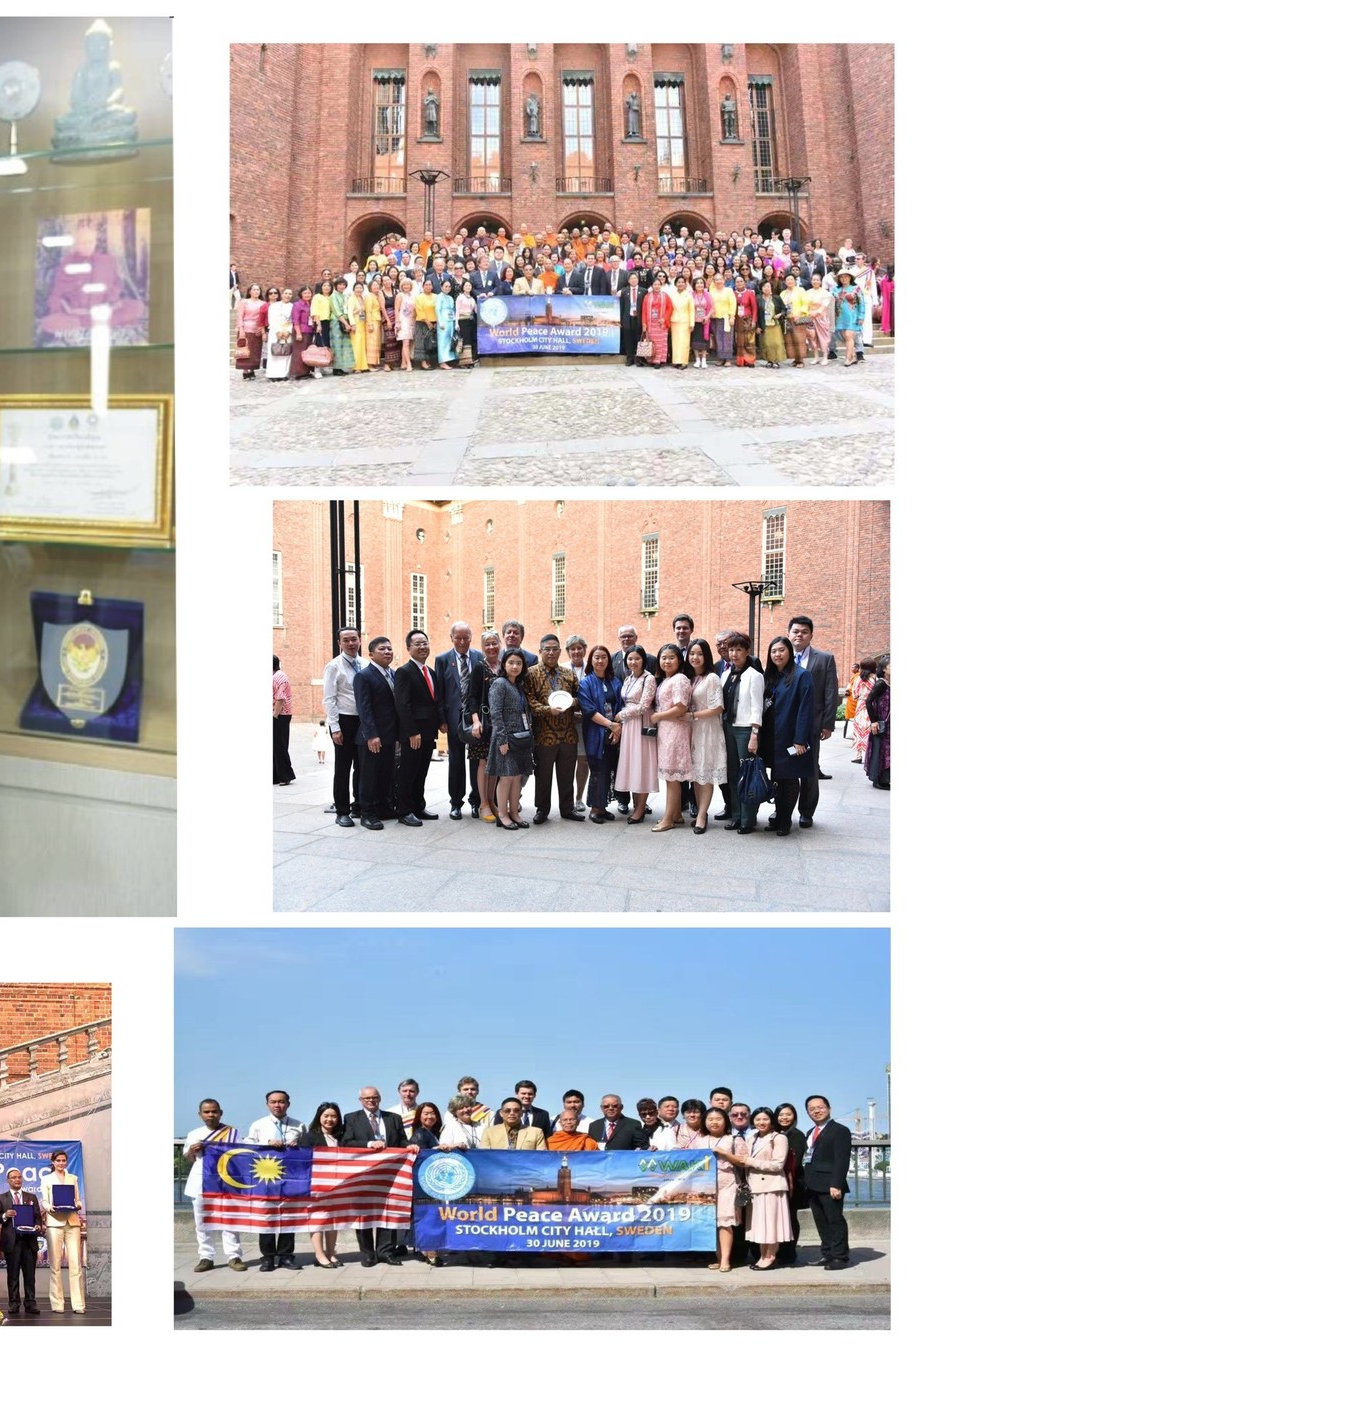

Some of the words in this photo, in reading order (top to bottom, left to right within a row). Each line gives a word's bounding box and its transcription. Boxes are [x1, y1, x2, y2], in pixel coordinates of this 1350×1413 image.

[490, 328, 519, 337] World
[521, 327, 548, 336] Peace
[550, 328, 581, 336] Award
[584, 328, 609, 336] 2019
[0, 1152, 14, 1160] CITY
[438, 1206, 498, 1221] World
[503, 1207, 562, 1222] Peace
[568, 1207, 635, 1222] Award
[640, 1207, 691, 1222] 2019
[455, 1225, 538, 1235] STOCKHOLM
[541, 1226, 571, 1236] CITY
[575, 1226, 613, 1237] HALL,
[616, 1226, 674, 1236] SWEDEN
[526, 1239, 540, 1248] 30
[542, 1239, 570, 1249] JUNE
[573, 1239, 600, 1248] 2019
